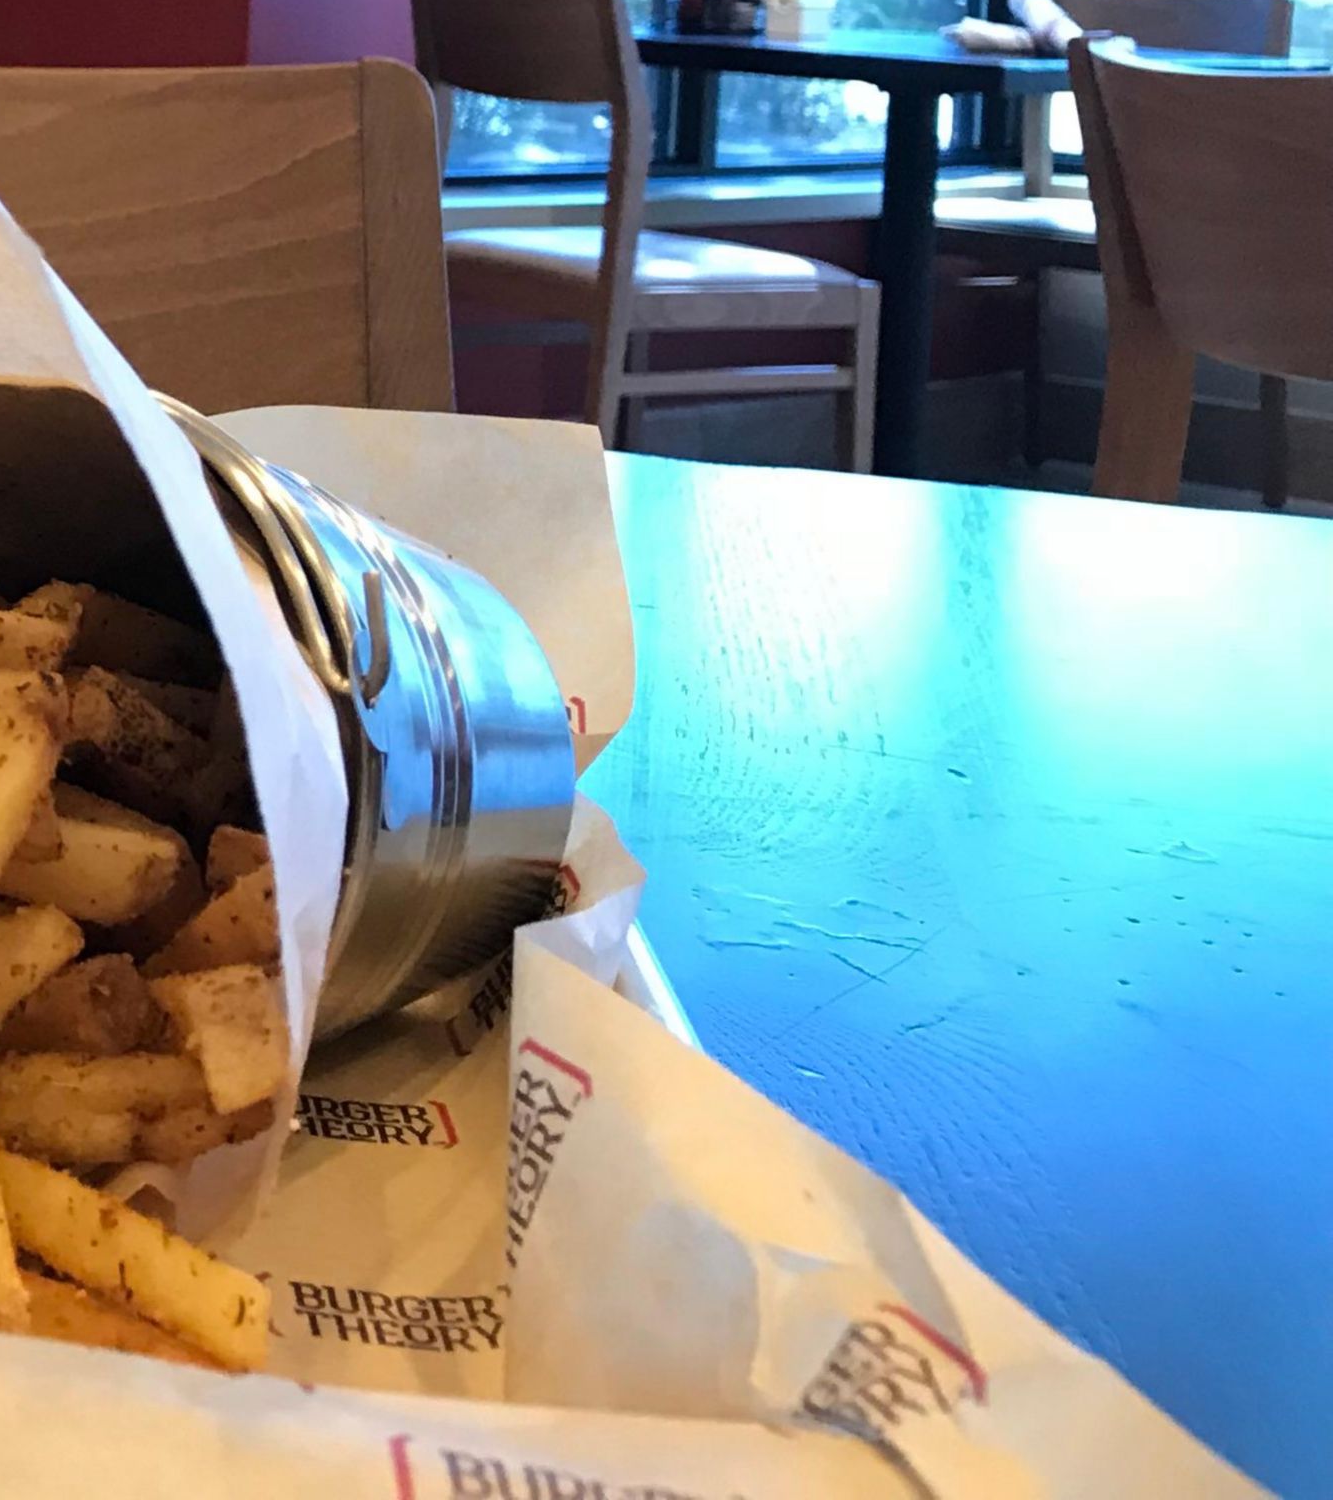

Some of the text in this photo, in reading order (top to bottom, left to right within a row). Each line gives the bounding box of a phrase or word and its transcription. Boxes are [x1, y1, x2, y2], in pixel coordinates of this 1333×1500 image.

[294, 1094, 434, 1125] URGER
[288, 1280, 504, 1325] BURGER
[294, 1308, 505, 1353] THEORY
